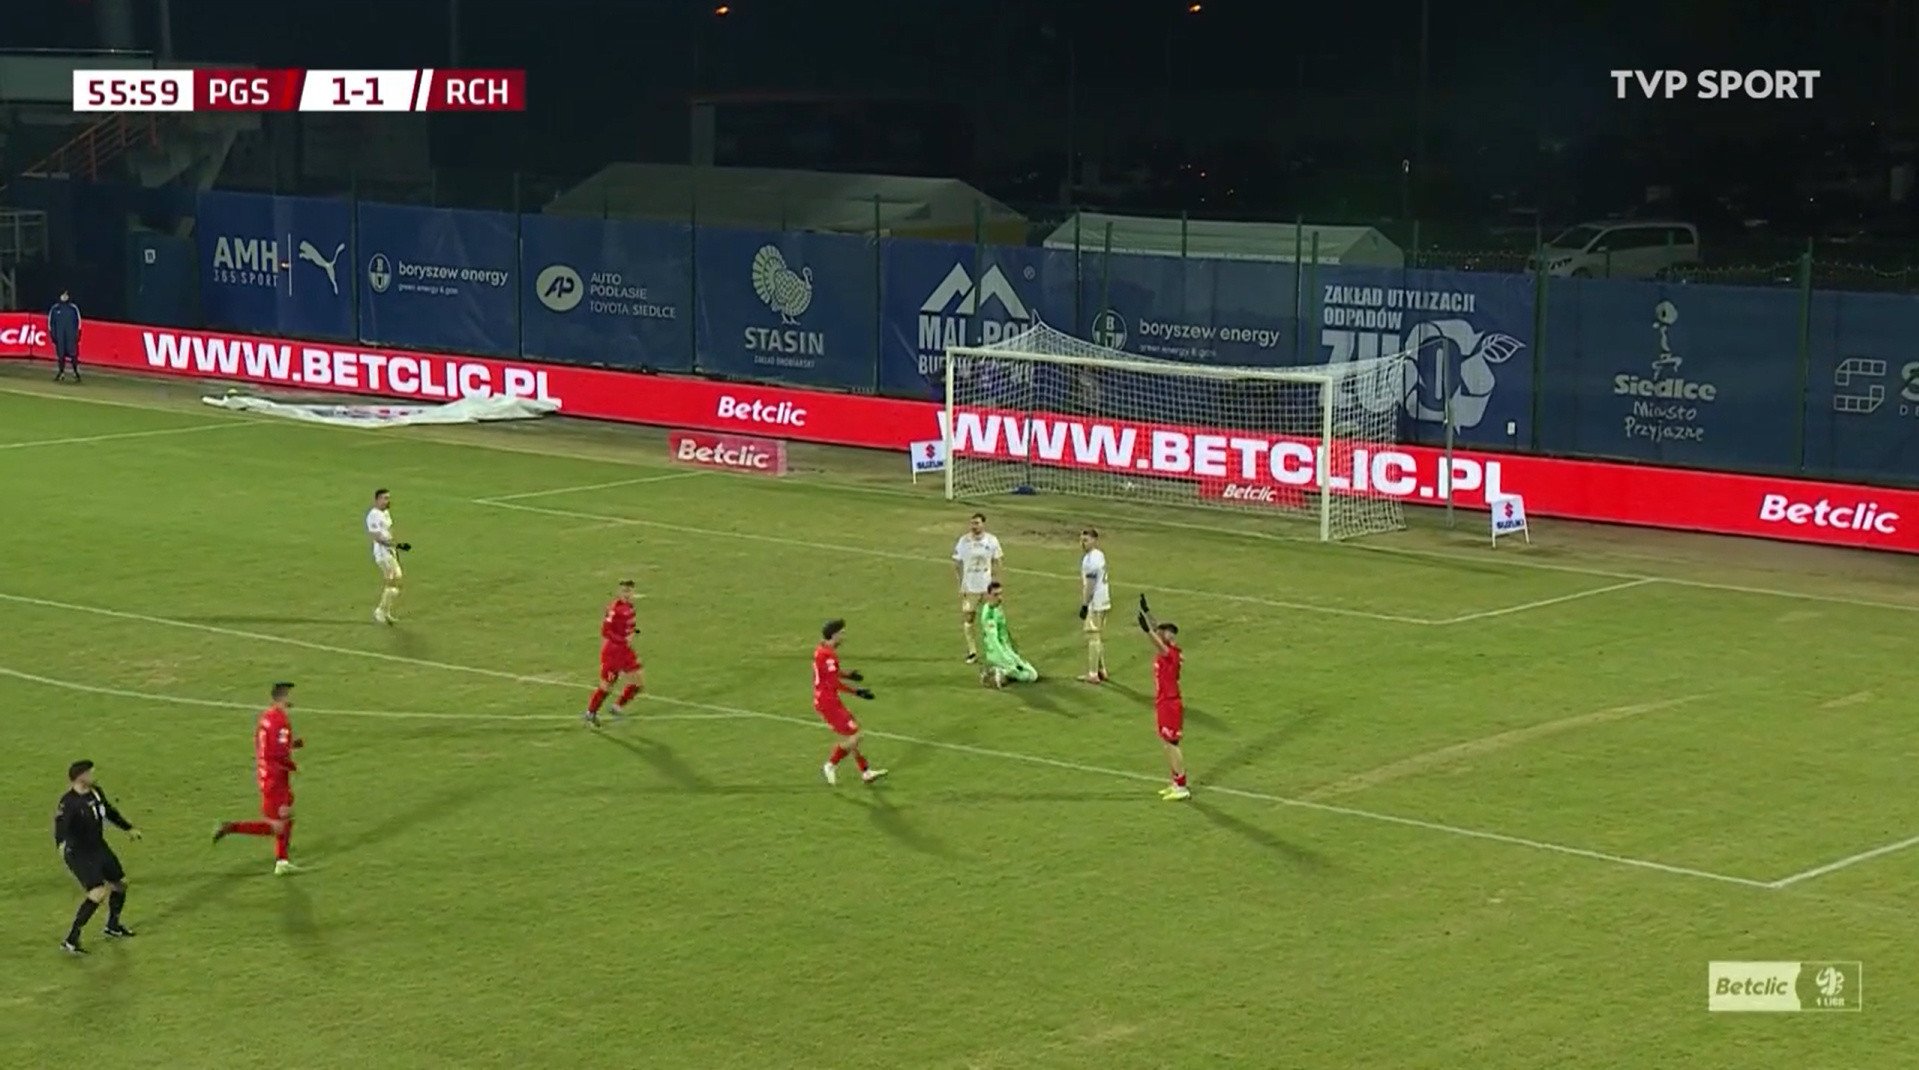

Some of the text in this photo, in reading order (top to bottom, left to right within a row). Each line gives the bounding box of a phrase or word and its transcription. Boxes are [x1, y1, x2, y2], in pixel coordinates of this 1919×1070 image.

[213, 236, 279, 272] AMH
[214, 269, 279, 288] 365 SPORT
[399, 260, 508, 287] boryszew energy
[590, 272, 622, 285] AUTO
[590, 285, 647, 300] PODLASIE
[1324, 285, 1476, 312] ZAKŁAD UTYLIZACJI
[590, 301, 677, 319] TOYOTA SIEDLCE
[1324, 306, 1402, 330] ODPADÓW
[744, 326, 824, 356] STASIN
[1139, 318, 1280, 347] boryszew energy
[143, 331, 561, 400] WWW.BETCLIC.PL
[1614, 374, 1717, 401] Siedlce
[718, 395, 807, 427] Betclic
[1633, 400, 1697, 420] Miasto
[1624, 416, 1704, 442] Przyjazne
[678, 438, 769, 469] Betclic
[937, 411, 1522, 503] WWW.BETCLIC.PL
[1222, 483, 1278, 502] Betclic
[1759, 493, 1900, 534] Betclic
